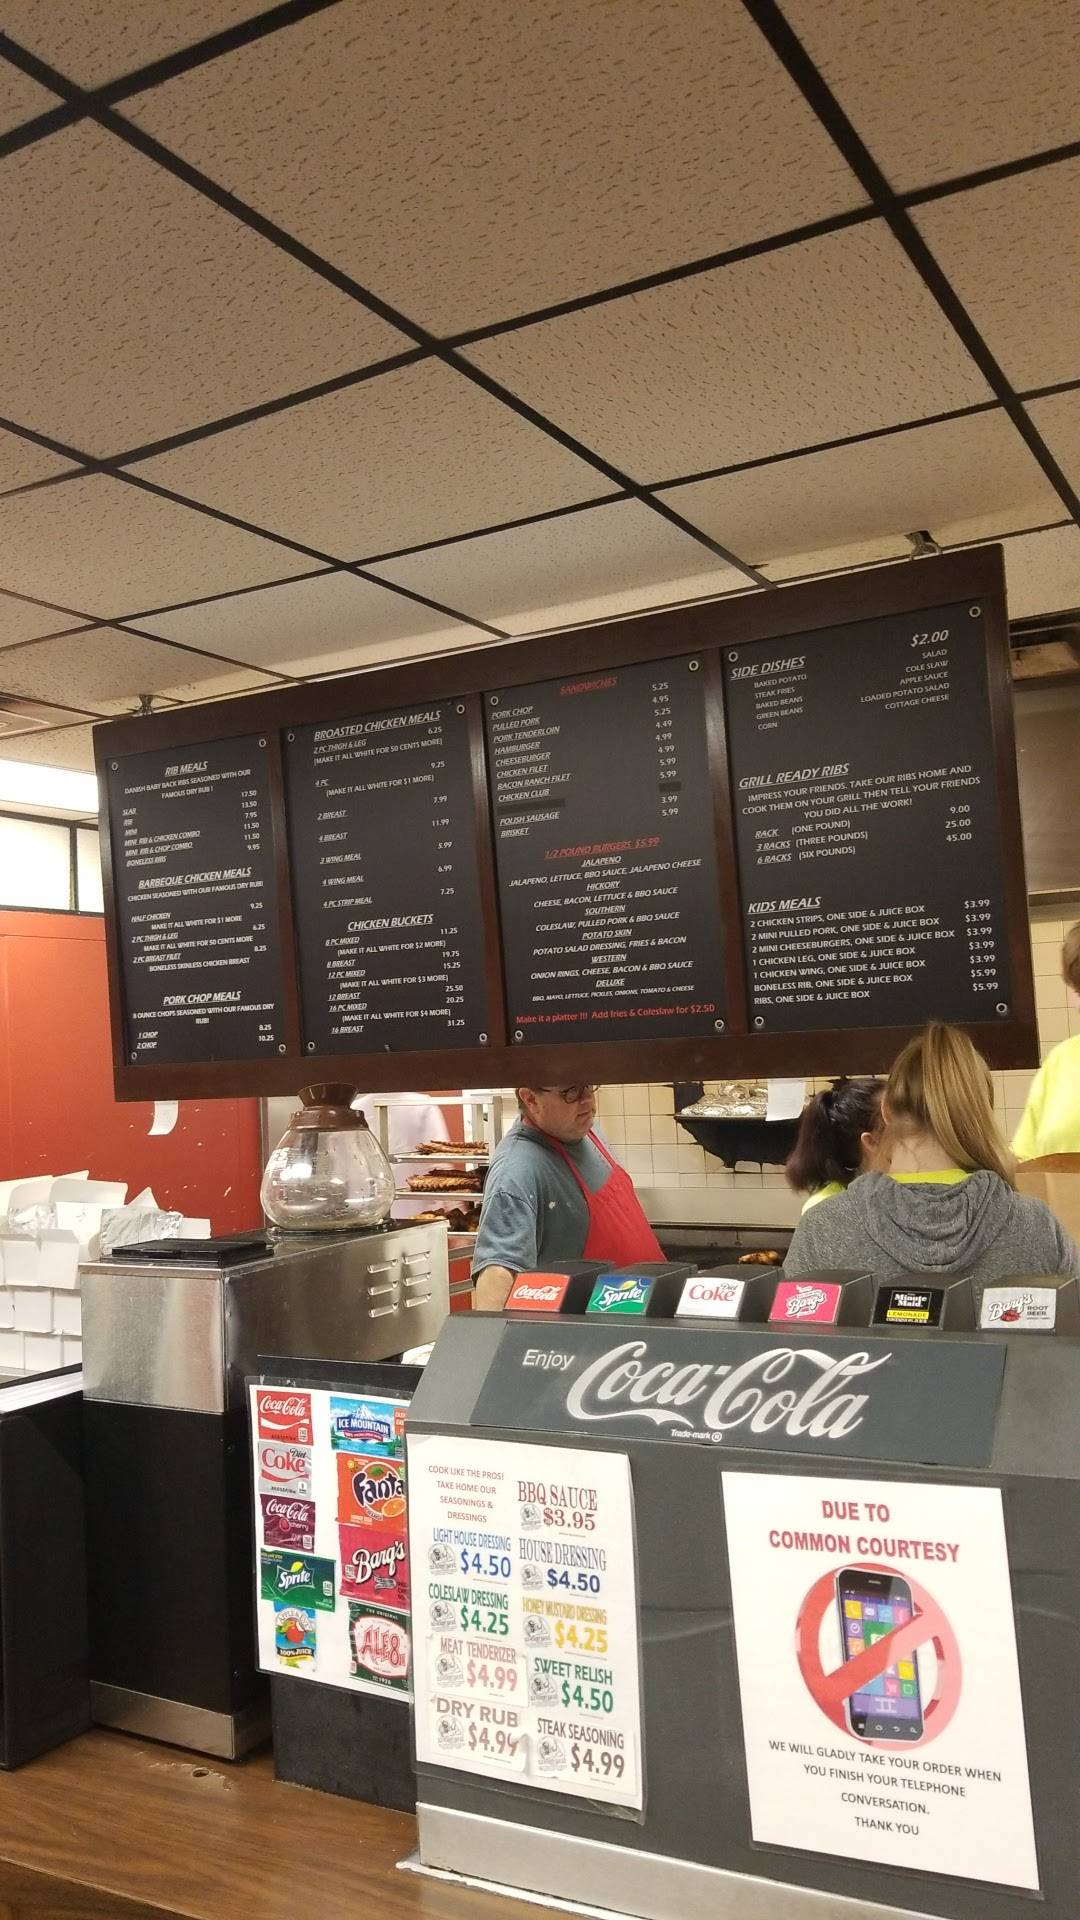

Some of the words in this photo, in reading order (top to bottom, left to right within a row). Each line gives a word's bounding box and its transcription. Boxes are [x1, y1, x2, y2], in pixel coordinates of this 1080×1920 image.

[911, 630, 949, 647] $2.00
[731, 666, 759, 679] SIDE
[762, 656, 805, 673] DISHES
[560, 677, 618, 695] SANDWICHES
[314, 724, 363, 740] BROASTED
[365, 716, 407, 732] CHICKEN
[409, 711, 441, 724] MEALS
[165, 766, 178, 775] RIB
[180, 761, 208, 774] MEALS
[496, 753, 550, 766] CHEESEBURGER
[739, 775, 773, 788] GRILL
[776, 770, 820, 783] READY
[822, 764, 850, 777] RIBS
[748, 790, 782, 802] IMPRESS
[783, 788, 808, 797] YOUR
[851, 778, 873, 788] TAKE
[875, 776, 895, 785] OUR
[898, 773, 917, 782] RIBS
[919, 768, 948, 778] HOME
[950, 765, 972, 774] AND
[950, 805, 970, 814] 9.00
[945, 819, 971, 828] 25.00
[946, 833, 972, 842] 45.00
[581, 856, 621, 867] JALAPENO
[138, 876, 182, 888] BARBEQUE
[185, 871, 222, 882] CHICKEN
[223, 868, 252, 878] MEALS
[587, 881, 620, 890] HICKORY
[585, 905, 625, 915] SOUTHERN
[748, 901, 776, 913] KIDS
[779, 897, 821, 910] MEALS
[348, 919, 389, 931] CHICKEN
[391, 914, 433, 927] BUCKETS
[757, 918, 794, 927] CHICKEN
[827, 913, 846, 921] ONE
[848, 911, 867, 919] SIDE
[878, 907, 903, 916] JUICE
[905, 905, 925, 913] BOX
[582, 931, 613, 939] POTATO
[615, 929, 632, 937] SKIN
[592, 954, 627, 963] WESTERN
[381, 978, 402, 986] WHITE
[596, 979, 625, 987] DELUXE
[163, 997, 186, 1005] PORK
[188, 994, 212, 1003] CHOP
[213, 991, 241, 1001] MEALS
[516, 1015, 537, 1024] Make
[552, 1013, 578, 1023] platter
[592, 1010, 609, 1019] Add
[638, 1006, 674, 1016] Coleslaw
[676, 1006, 688, 1014] for
[691, 1004, 715, 1013] $2.50
[599, 1289, 643, 1305] Sprite
[690, 1285, 735, 1301] Coke
[988, 1294, 1033, 1321] Barq's
[522, 1350, 574, 1371] Enjoy
[566, 1341, 893, 1438] Coca-Cola
[260, 1396, 309, 1416] Coca-Cola
[338, 1419, 349, 1428] ICE
[351, 1419, 389, 1435] MOUNTAIN
[262, 1448, 306, 1472] Coke
[290, 1448, 307, 1458] Diet
[429, 1466, 450, 1474] COOK
[451, 1468, 465, 1476] LIKE
[482, 1472, 504, 1480] PROS!
[353, 1472, 404, 1508] Fanta
[437, 1481, 455, 1489] TAKE
[456, 1484, 478, 1492] HOME
[480, 1486, 496, 1494] OUR
[518, 1481, 546, 1505] BBQ
[551, 1485, 598, 1511] SAUCE
[266, 1499, 311, 1520] Coca-Cola
[440, 1496, 486, 1508] SEASONINGS
[822, 1500, 859, 1520] DUE
[864, 1503, 890, 1522] TO
[448, 1512, 487, 1523] DRESSINGS
[543, 1508, 596, 1530] $3.95
[434, 1528, 452, 1543] LIGHT
[454, 1531, 477, 1547] HOUSE
[479, 1535, 511, 1551] DRESSING
[769, 1530, 850, 1553] COMMON
[857, 1537, 960, 1562] COURTESY
[353, 1541, 406, 1583] Barq's
[461, 1549, 511, 1577] $4.50
[519, 1538, 553, 1562] HOUSE
[556, 1543, 606, 1571] DRESSING
[278, 1569, 311, 1588] Sprite
[548, 1569, 600, 1593] $4.50
[429, 1583, 469, 1603] COLESLAW
[472, 1589, 509, 1609] DRESSING
[461, 1605, 509, 1635] $4.25
[522, 1598, 544, 1613] HONEY
[546, 1601, 575, 1619] MUSTARD
[577, 1605, 607, 1624] DRESSING
[555, 1621, 608, 1653] $4.25
[441, 1638, 463, 1655] MEAT
[467, 1641, 516, 1664] TENDERIZER
[467, 1660, 518, 1691] $4.99
[534, 1658, 572, 1678] SWEET
[575, 1665, 612, 1685] RELISH
[562, 1680, 614, 1713] $4.50
[437, 1698, 474, 1718] DRY
[480, 1704, 519, 1727] RUB
[537, 1719, 567, 1737] STEAK
[568, 1725, 624, 1749] SEASONING
[571, 1744, 625, 1778] $4.99
[769, 1740, 787, 1752] WE
[789, 1742, 814, 1756] WILL
[817, 1747, 855, 1762] GLADLY
[859, 1752, 885, 1766] TAKE
[889, 1756, 919, 1769] YOUR
[923, 1761, 962, 1775] ORDER
[965, 1768, 1001, 1781] WHEN
[803, 1764, 826, 1776] YOU
[830, 1768, 864, 1783] FINISH
[867, 1773, 897, 1786] YOUR
[901, 1777, 966, 1797] TELEPHONE
[841, 1793, 930, 1814] CONVERSATION.
[855, 1817, 892, 1831] THANK
[896, 1823, 919, 1836] YOU
